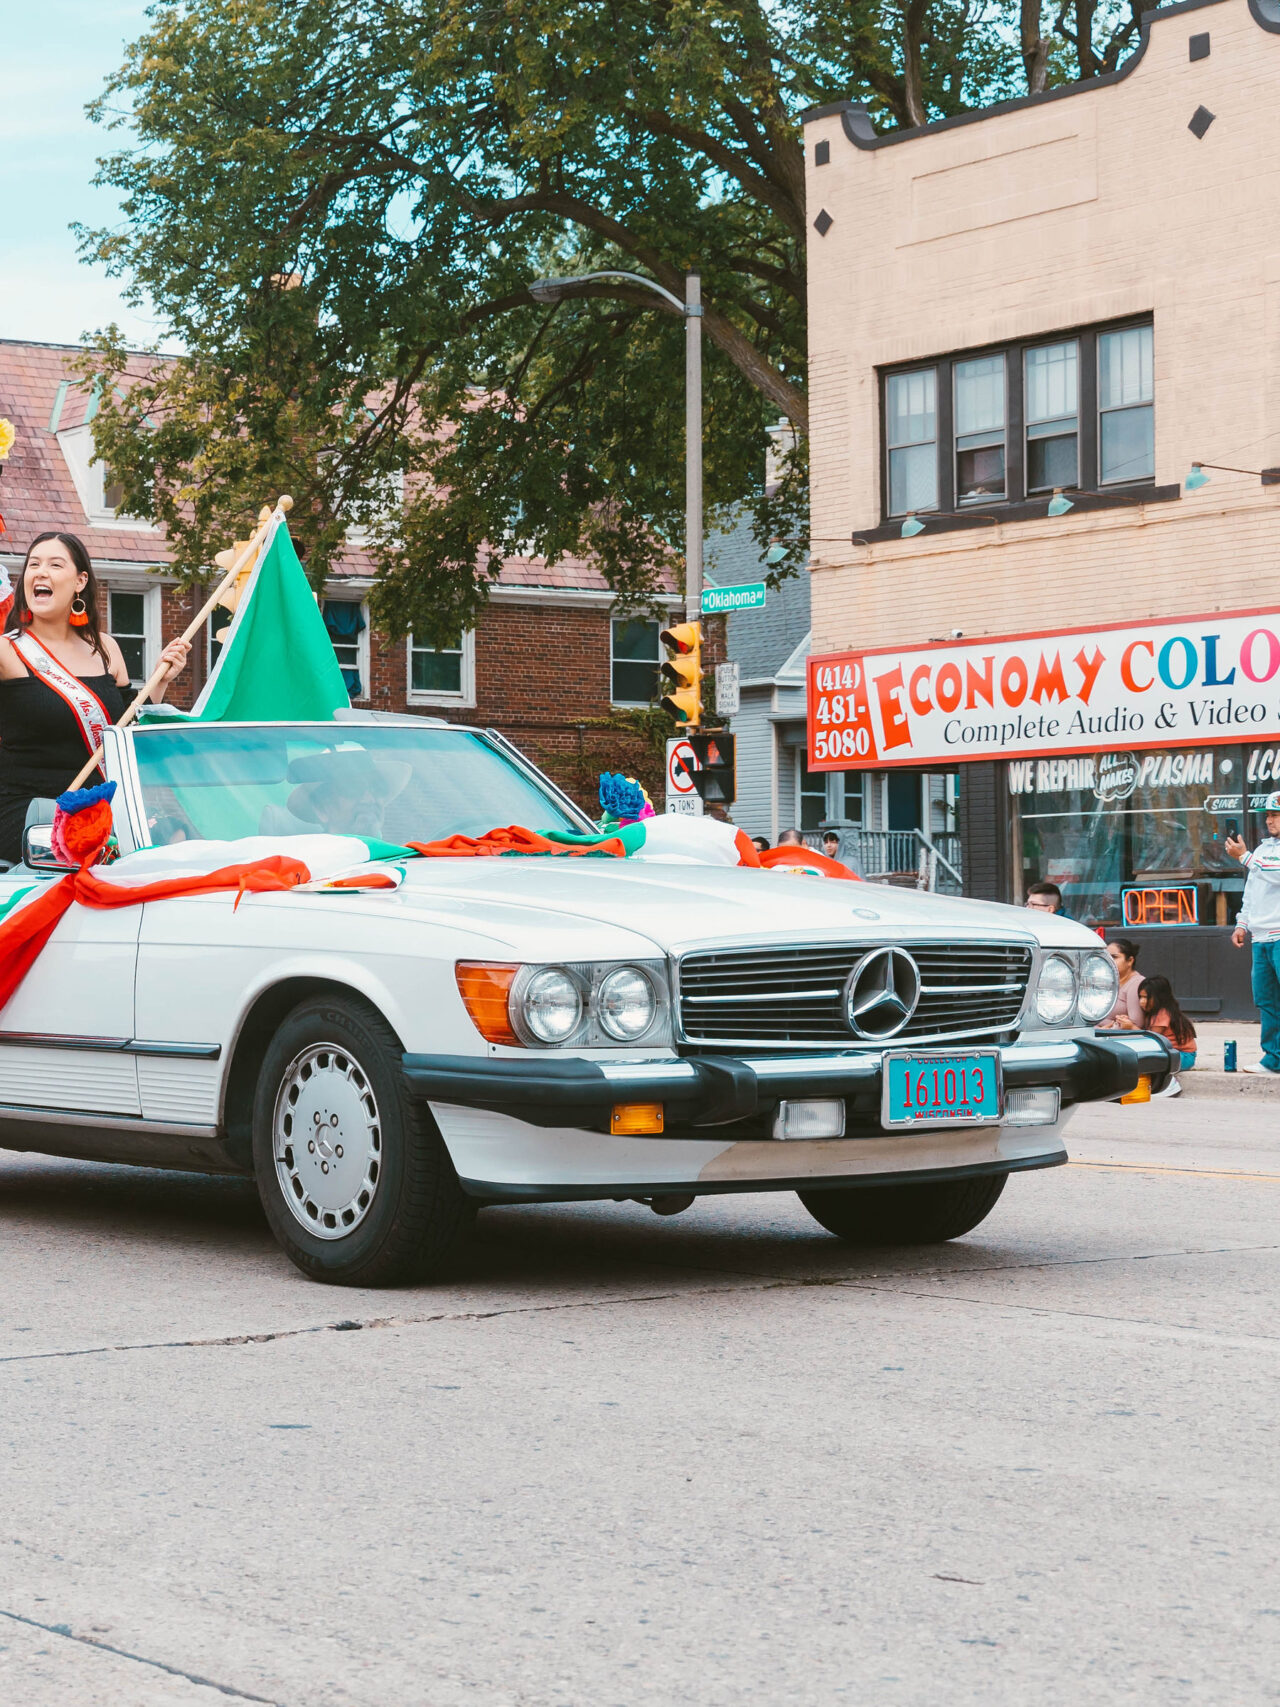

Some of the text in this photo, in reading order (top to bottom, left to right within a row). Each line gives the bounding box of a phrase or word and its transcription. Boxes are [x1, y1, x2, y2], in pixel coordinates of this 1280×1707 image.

[709, 591, 756, 609] Oklahoma
[816, 663, 861, 692] (414)
[816, 693, 867, 725] 481-
[872, 644, 1107, 752] ECONOMY
[944, 715, 1060, 745] Complete
[1066, 706, 1144, 735] Audio
[1154, 702, 1178, 729] &
[1188, 698, 1267, 726] Video
[814, 727, 870, 759] 5080
[1008, 758, 1095, 795] WE REPAIR
[1099, 754, 1118, 773] ALL
[1100, 768, 1134, 791] MAKES
[1138, 753, 1214, 788] PLASMA
[678, 799, 695, 811] TONS
[1211, 798, 1240, 811] SINCE
[1124, 889, 1196, 925] OPEN
[903, 1067, 984, 1107] 161013
[915, 1108, 973, 1119] WISCONSIN
